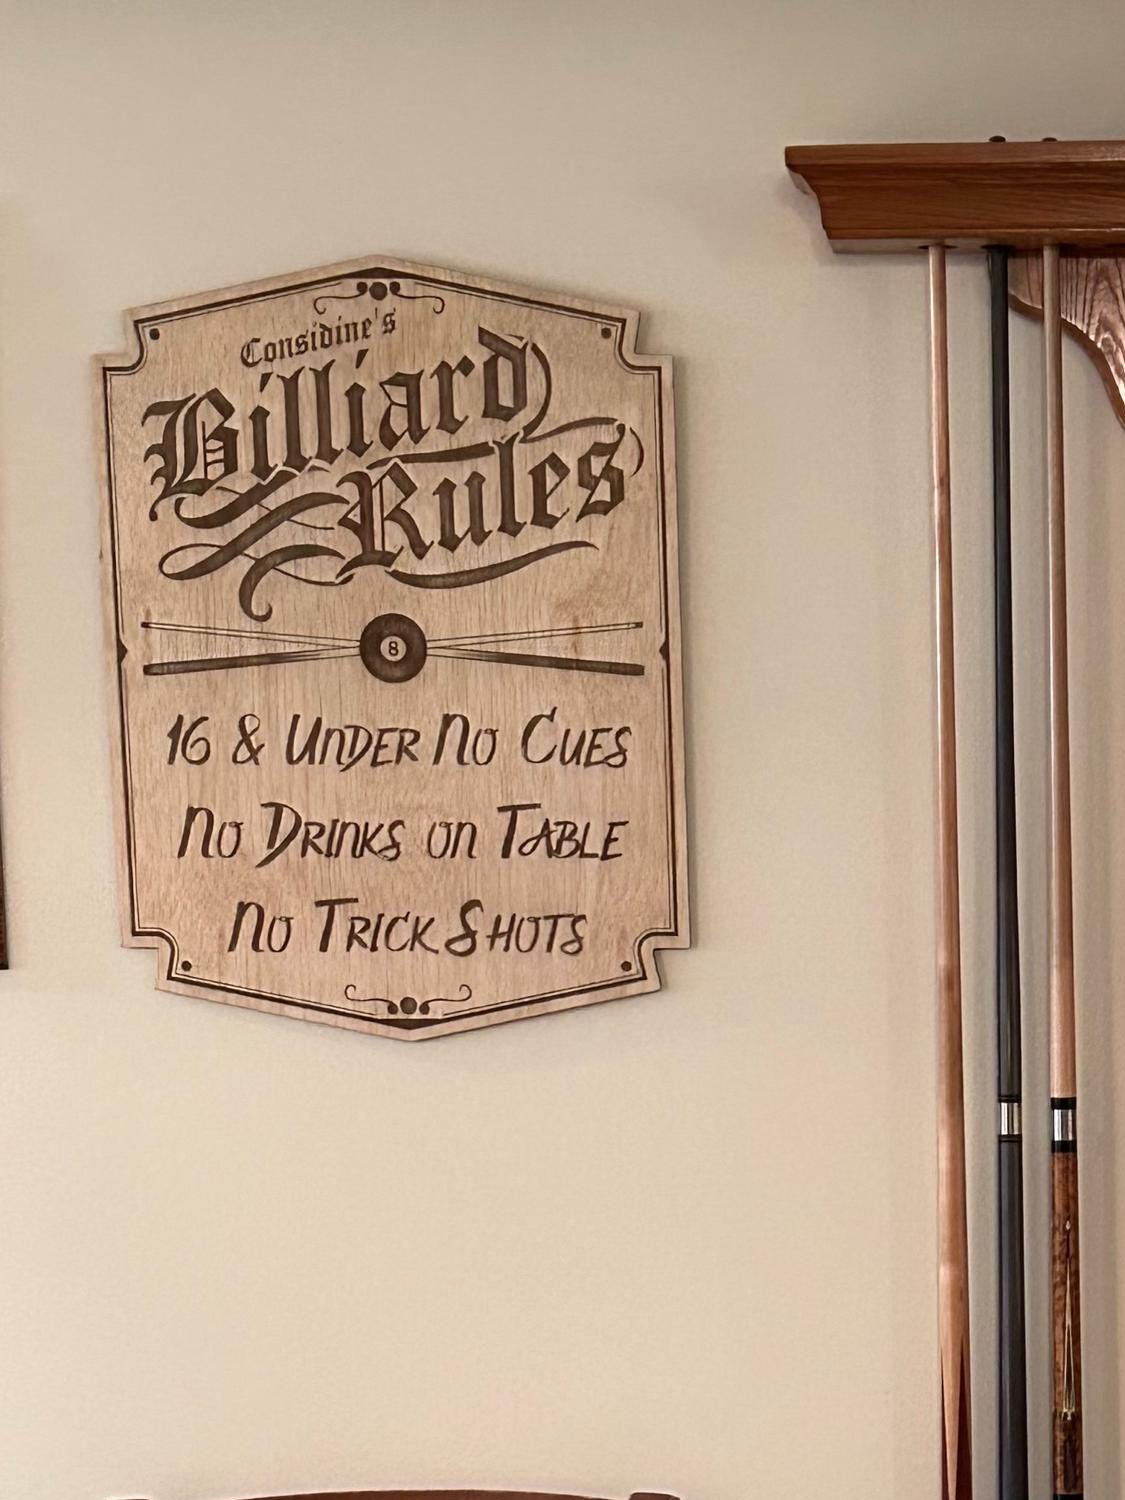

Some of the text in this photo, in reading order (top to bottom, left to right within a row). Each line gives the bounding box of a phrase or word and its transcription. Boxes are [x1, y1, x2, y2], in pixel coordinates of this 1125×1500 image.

[241, 308, 396, 368] Considine's
[142, 326, 531, 520] Billiard
[336, 424, 627, 570] Rules
[388, 641, 399, 657] 8
[167, 714, 212, 767] 16
[231, 713, 266, 767] &
